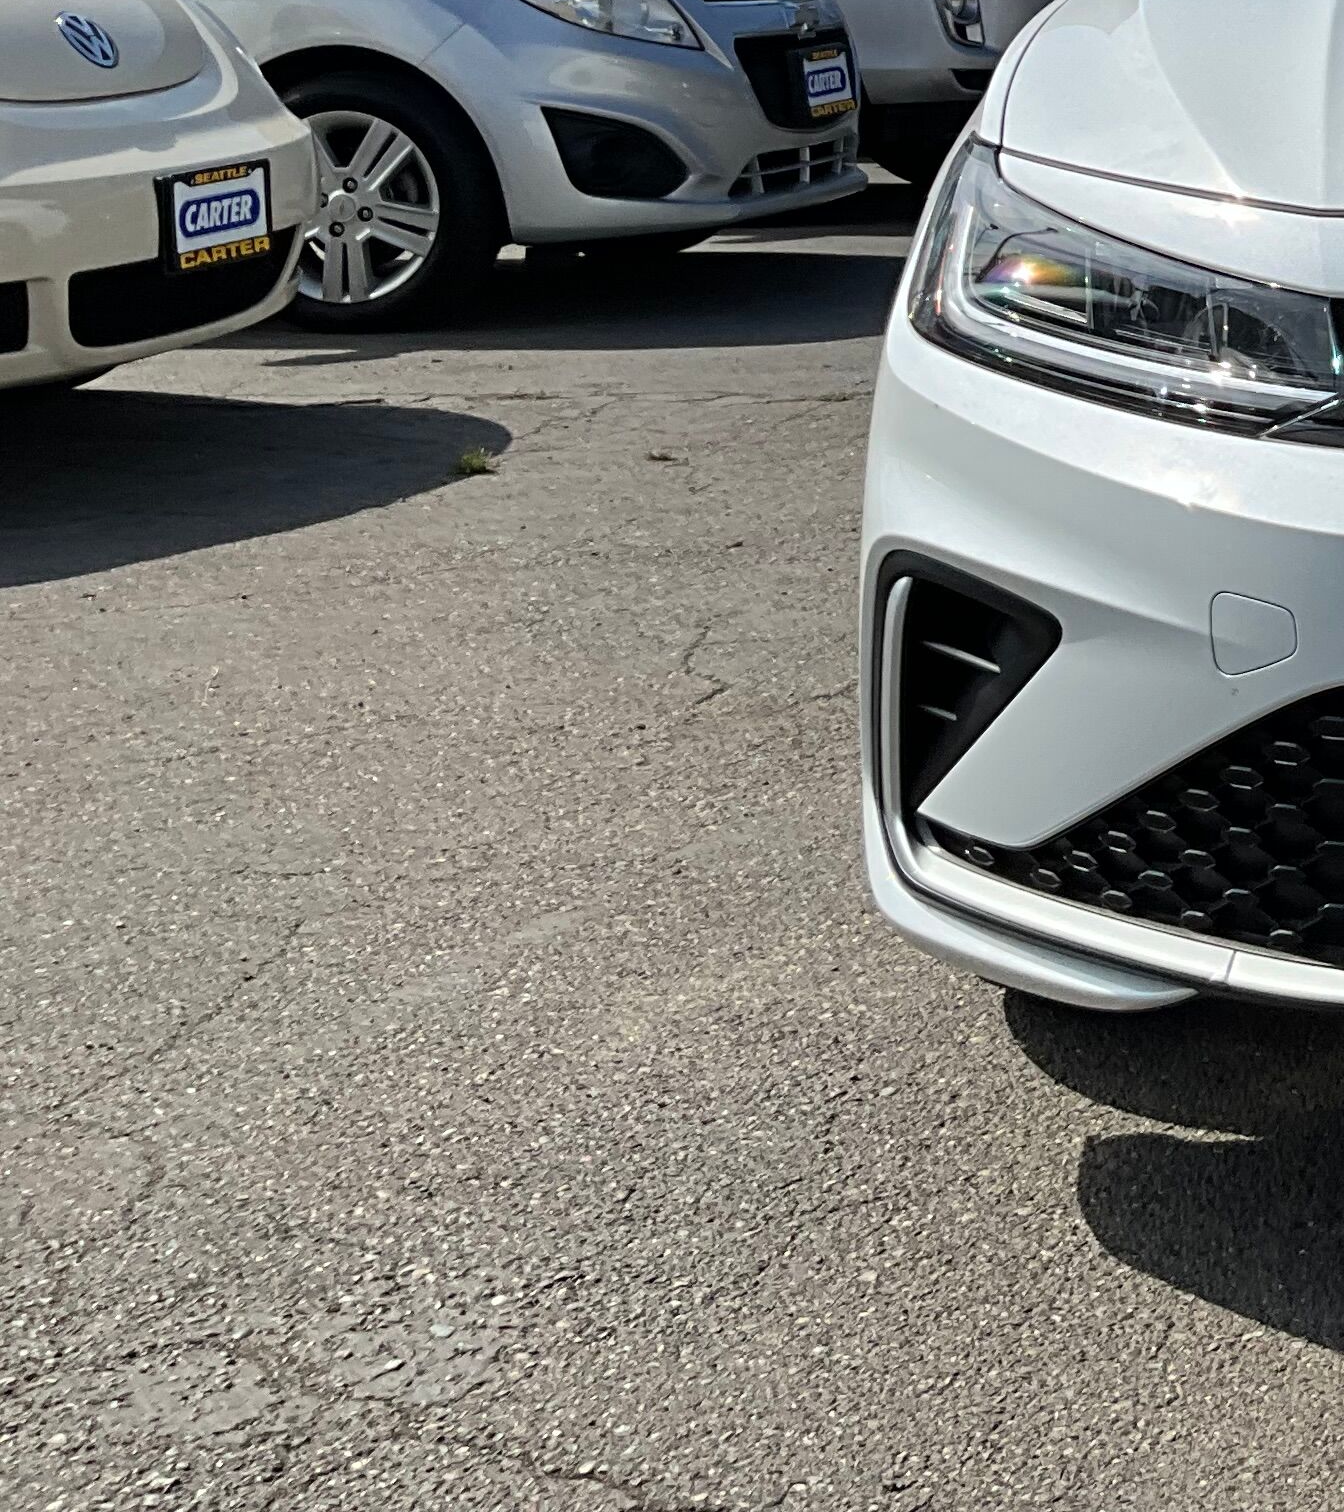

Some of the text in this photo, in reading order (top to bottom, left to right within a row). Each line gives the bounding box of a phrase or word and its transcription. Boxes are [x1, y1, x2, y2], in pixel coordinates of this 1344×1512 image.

[809, 71, 842, 93] CARTER
[194, 165, 248, 185] SEATTLE
[184, 194, 253, 232] CARTER
[180, 236, 270, 269] CARTER
